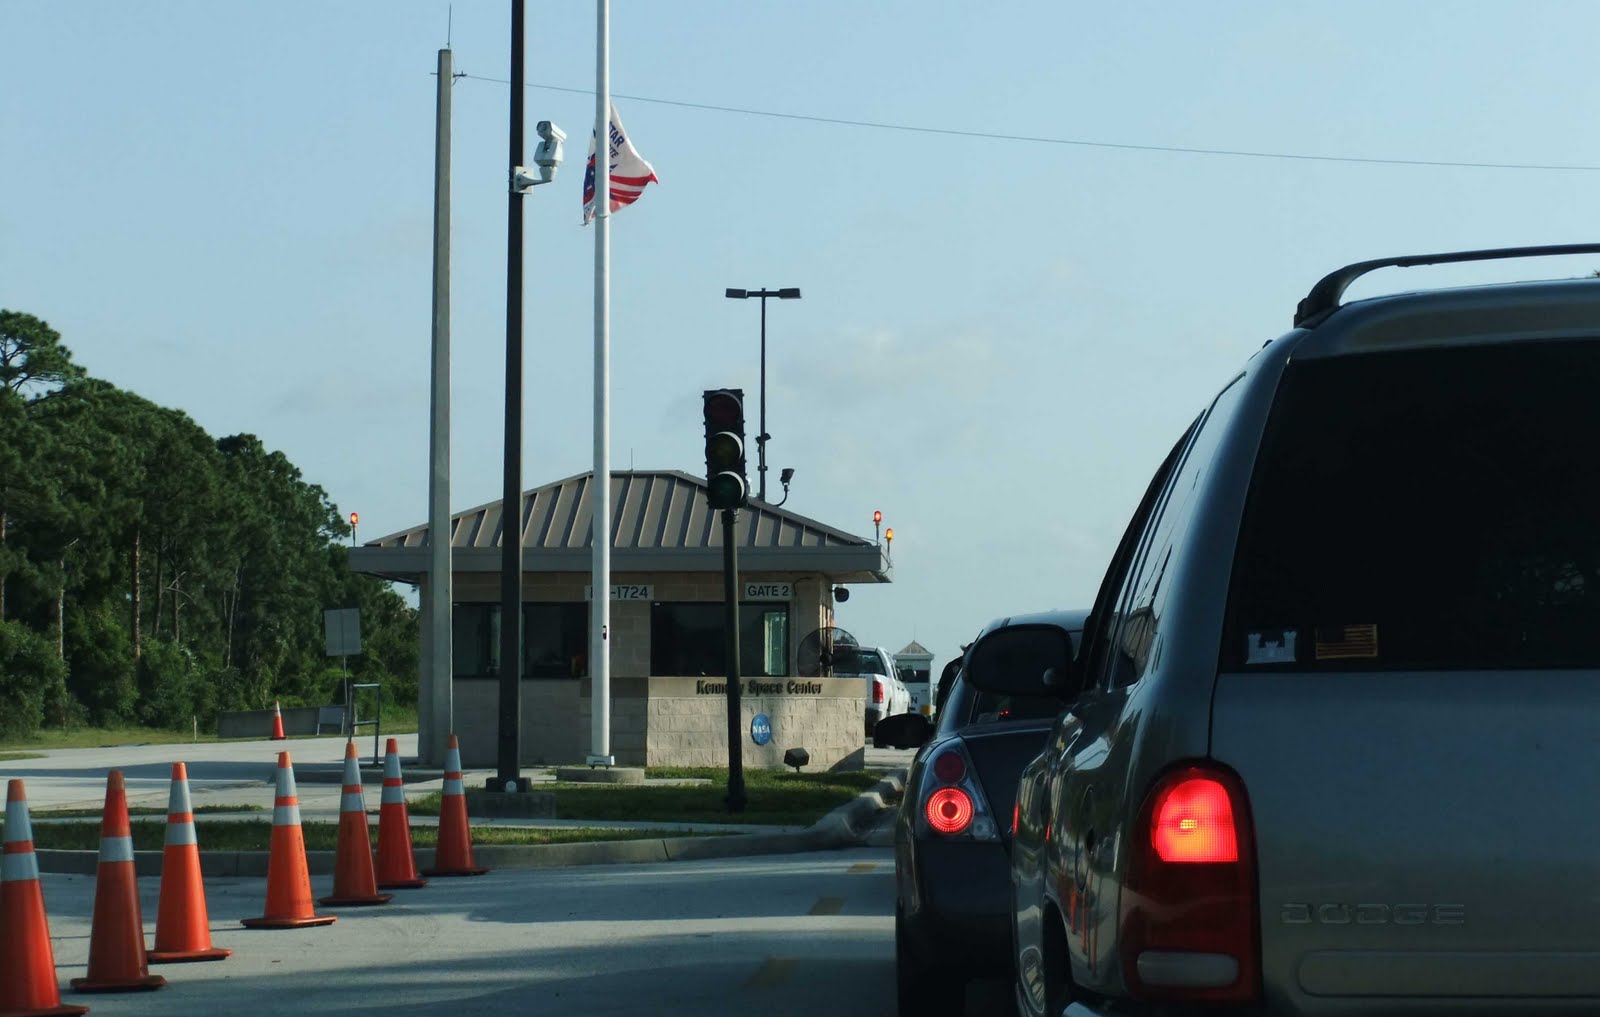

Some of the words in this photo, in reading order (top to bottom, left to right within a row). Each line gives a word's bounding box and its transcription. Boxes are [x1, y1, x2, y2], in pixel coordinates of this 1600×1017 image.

[747, 585, 779, 597] GATE
[782, 585, 789, 597] 2
[748, 681, 783, 696] Space
[786, 680, 823, 695] Center
[752, 725, 770, 734] NASA
[1280, 903, 1465, 925] DODGE
